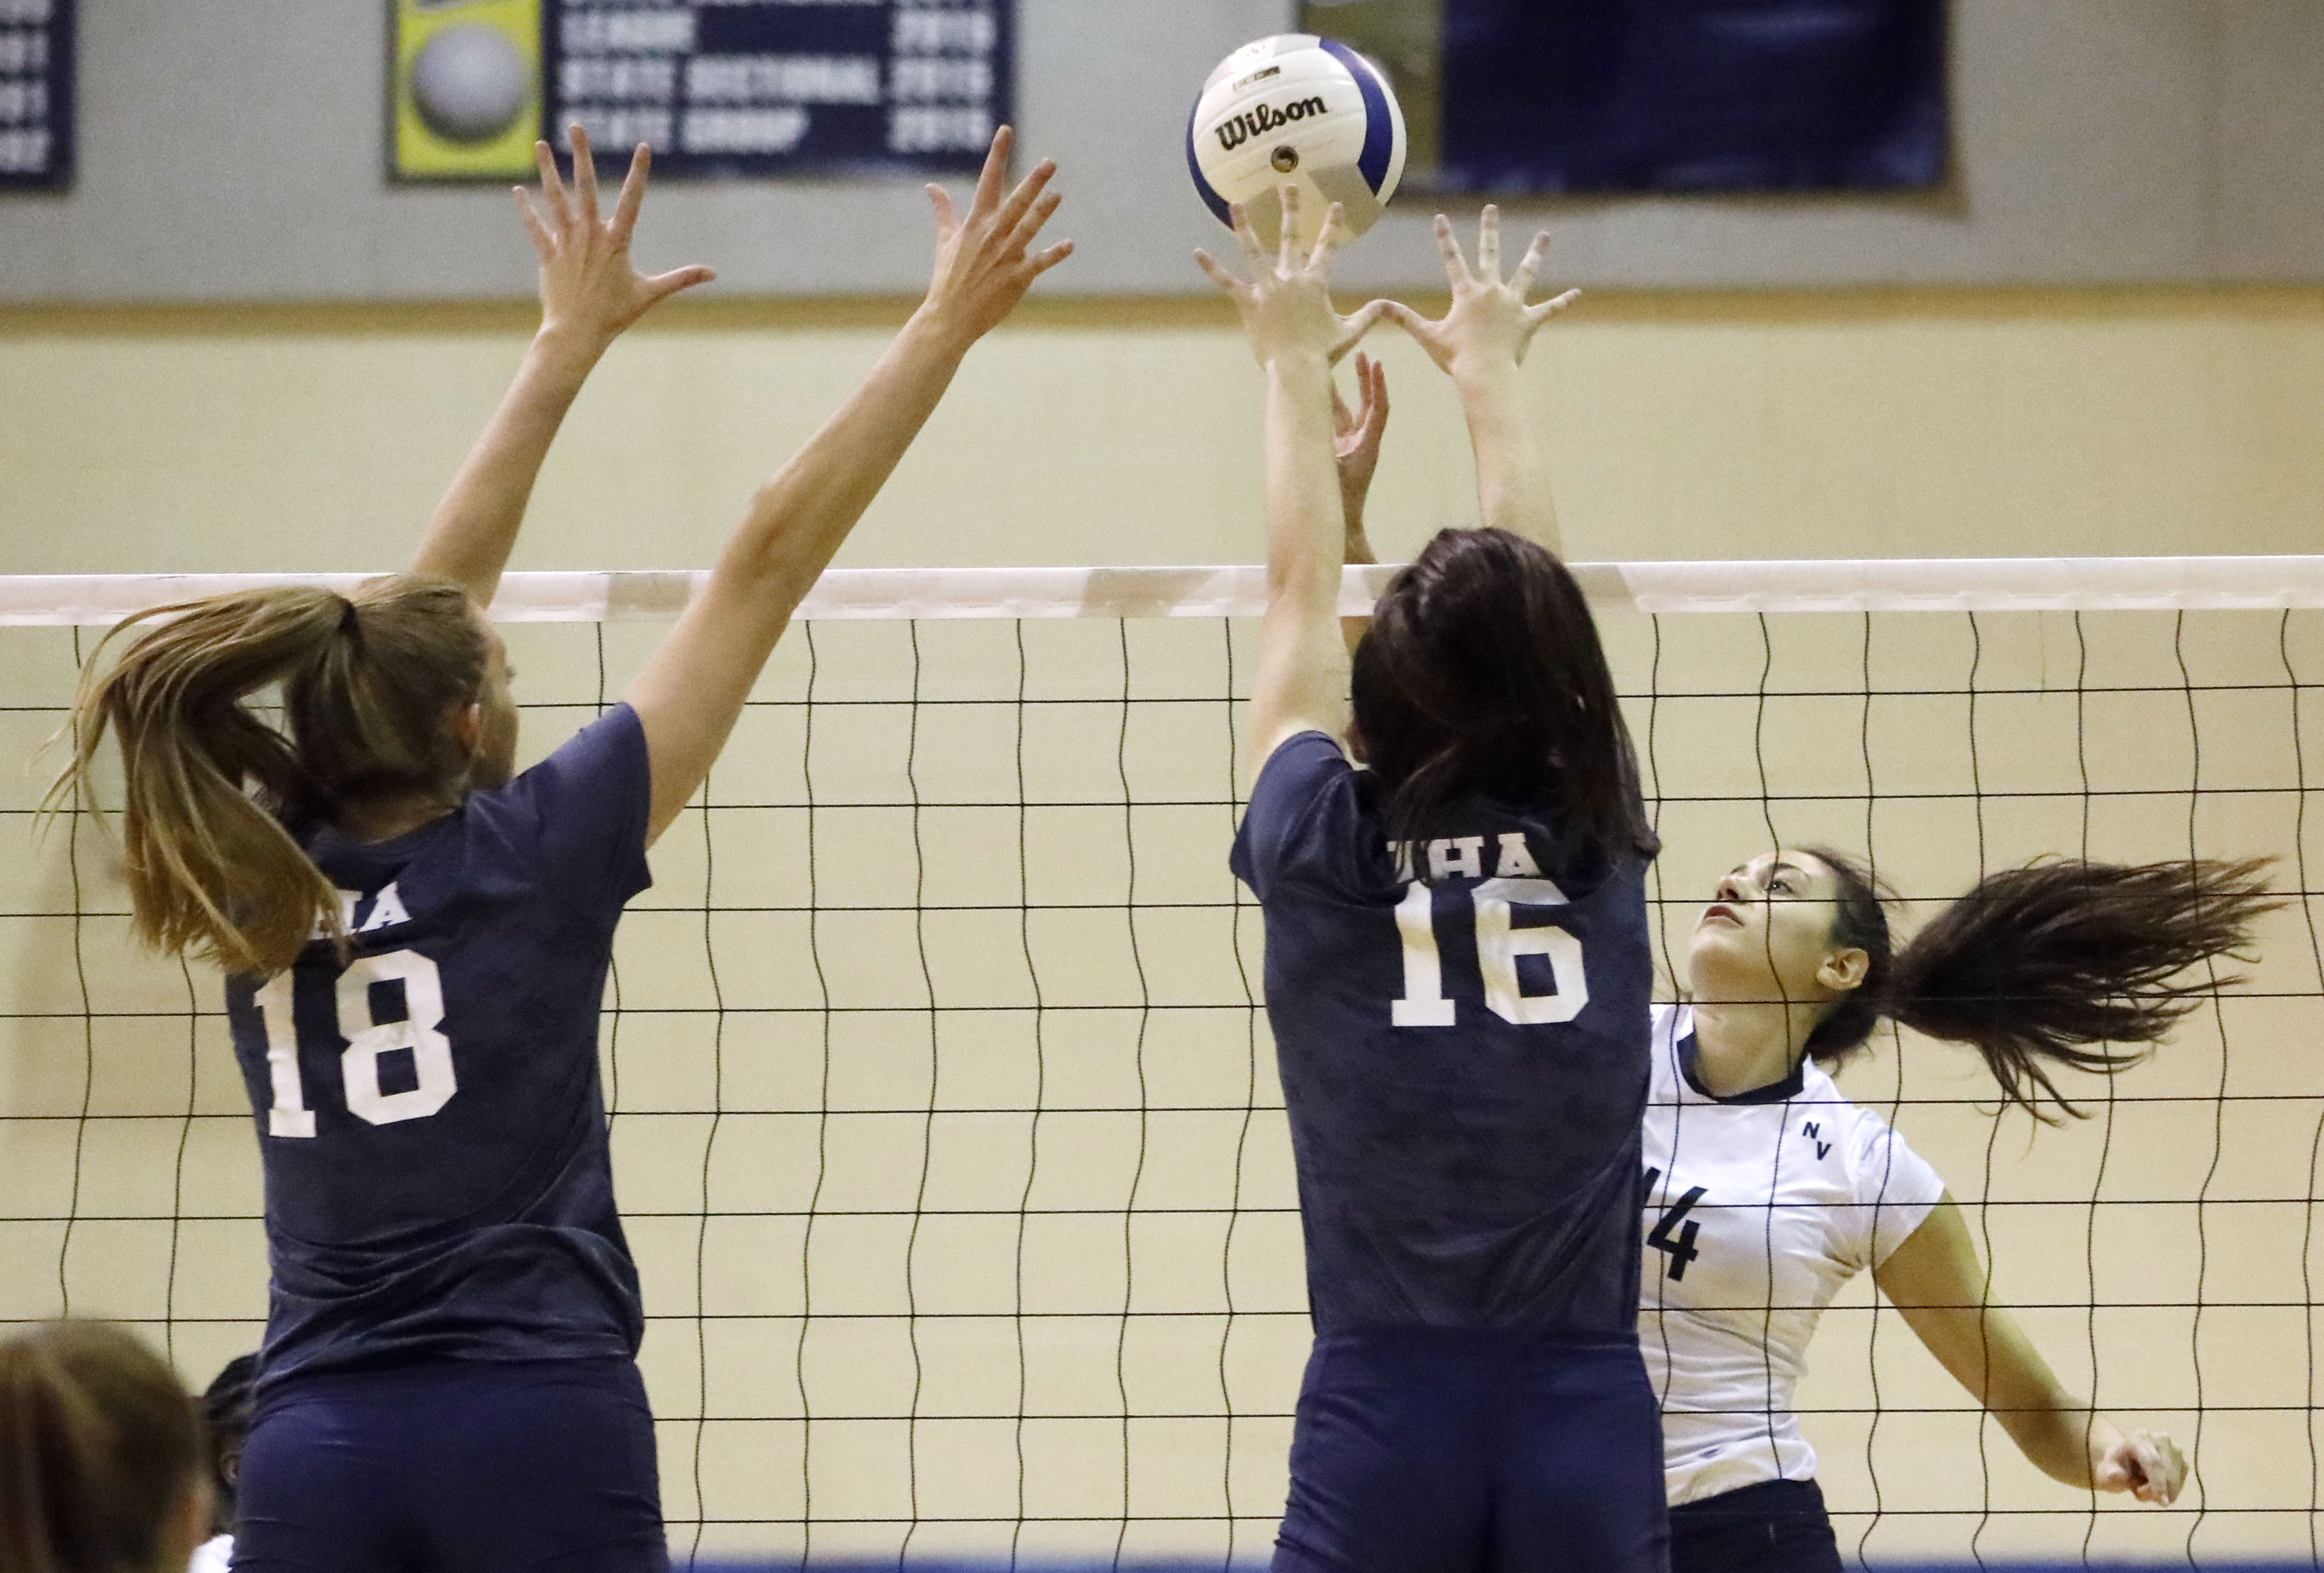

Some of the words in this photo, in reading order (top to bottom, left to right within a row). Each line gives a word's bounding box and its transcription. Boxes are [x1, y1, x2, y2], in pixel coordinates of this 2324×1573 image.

[1215, 97, 1328, 150] Wilson
[1392, 878, 1589, 1027] 16
[254, 949, 458, 1138] 18
[1802, 1121, 1820, 1140] N
[1816, 1140, 1832, 1161] V
